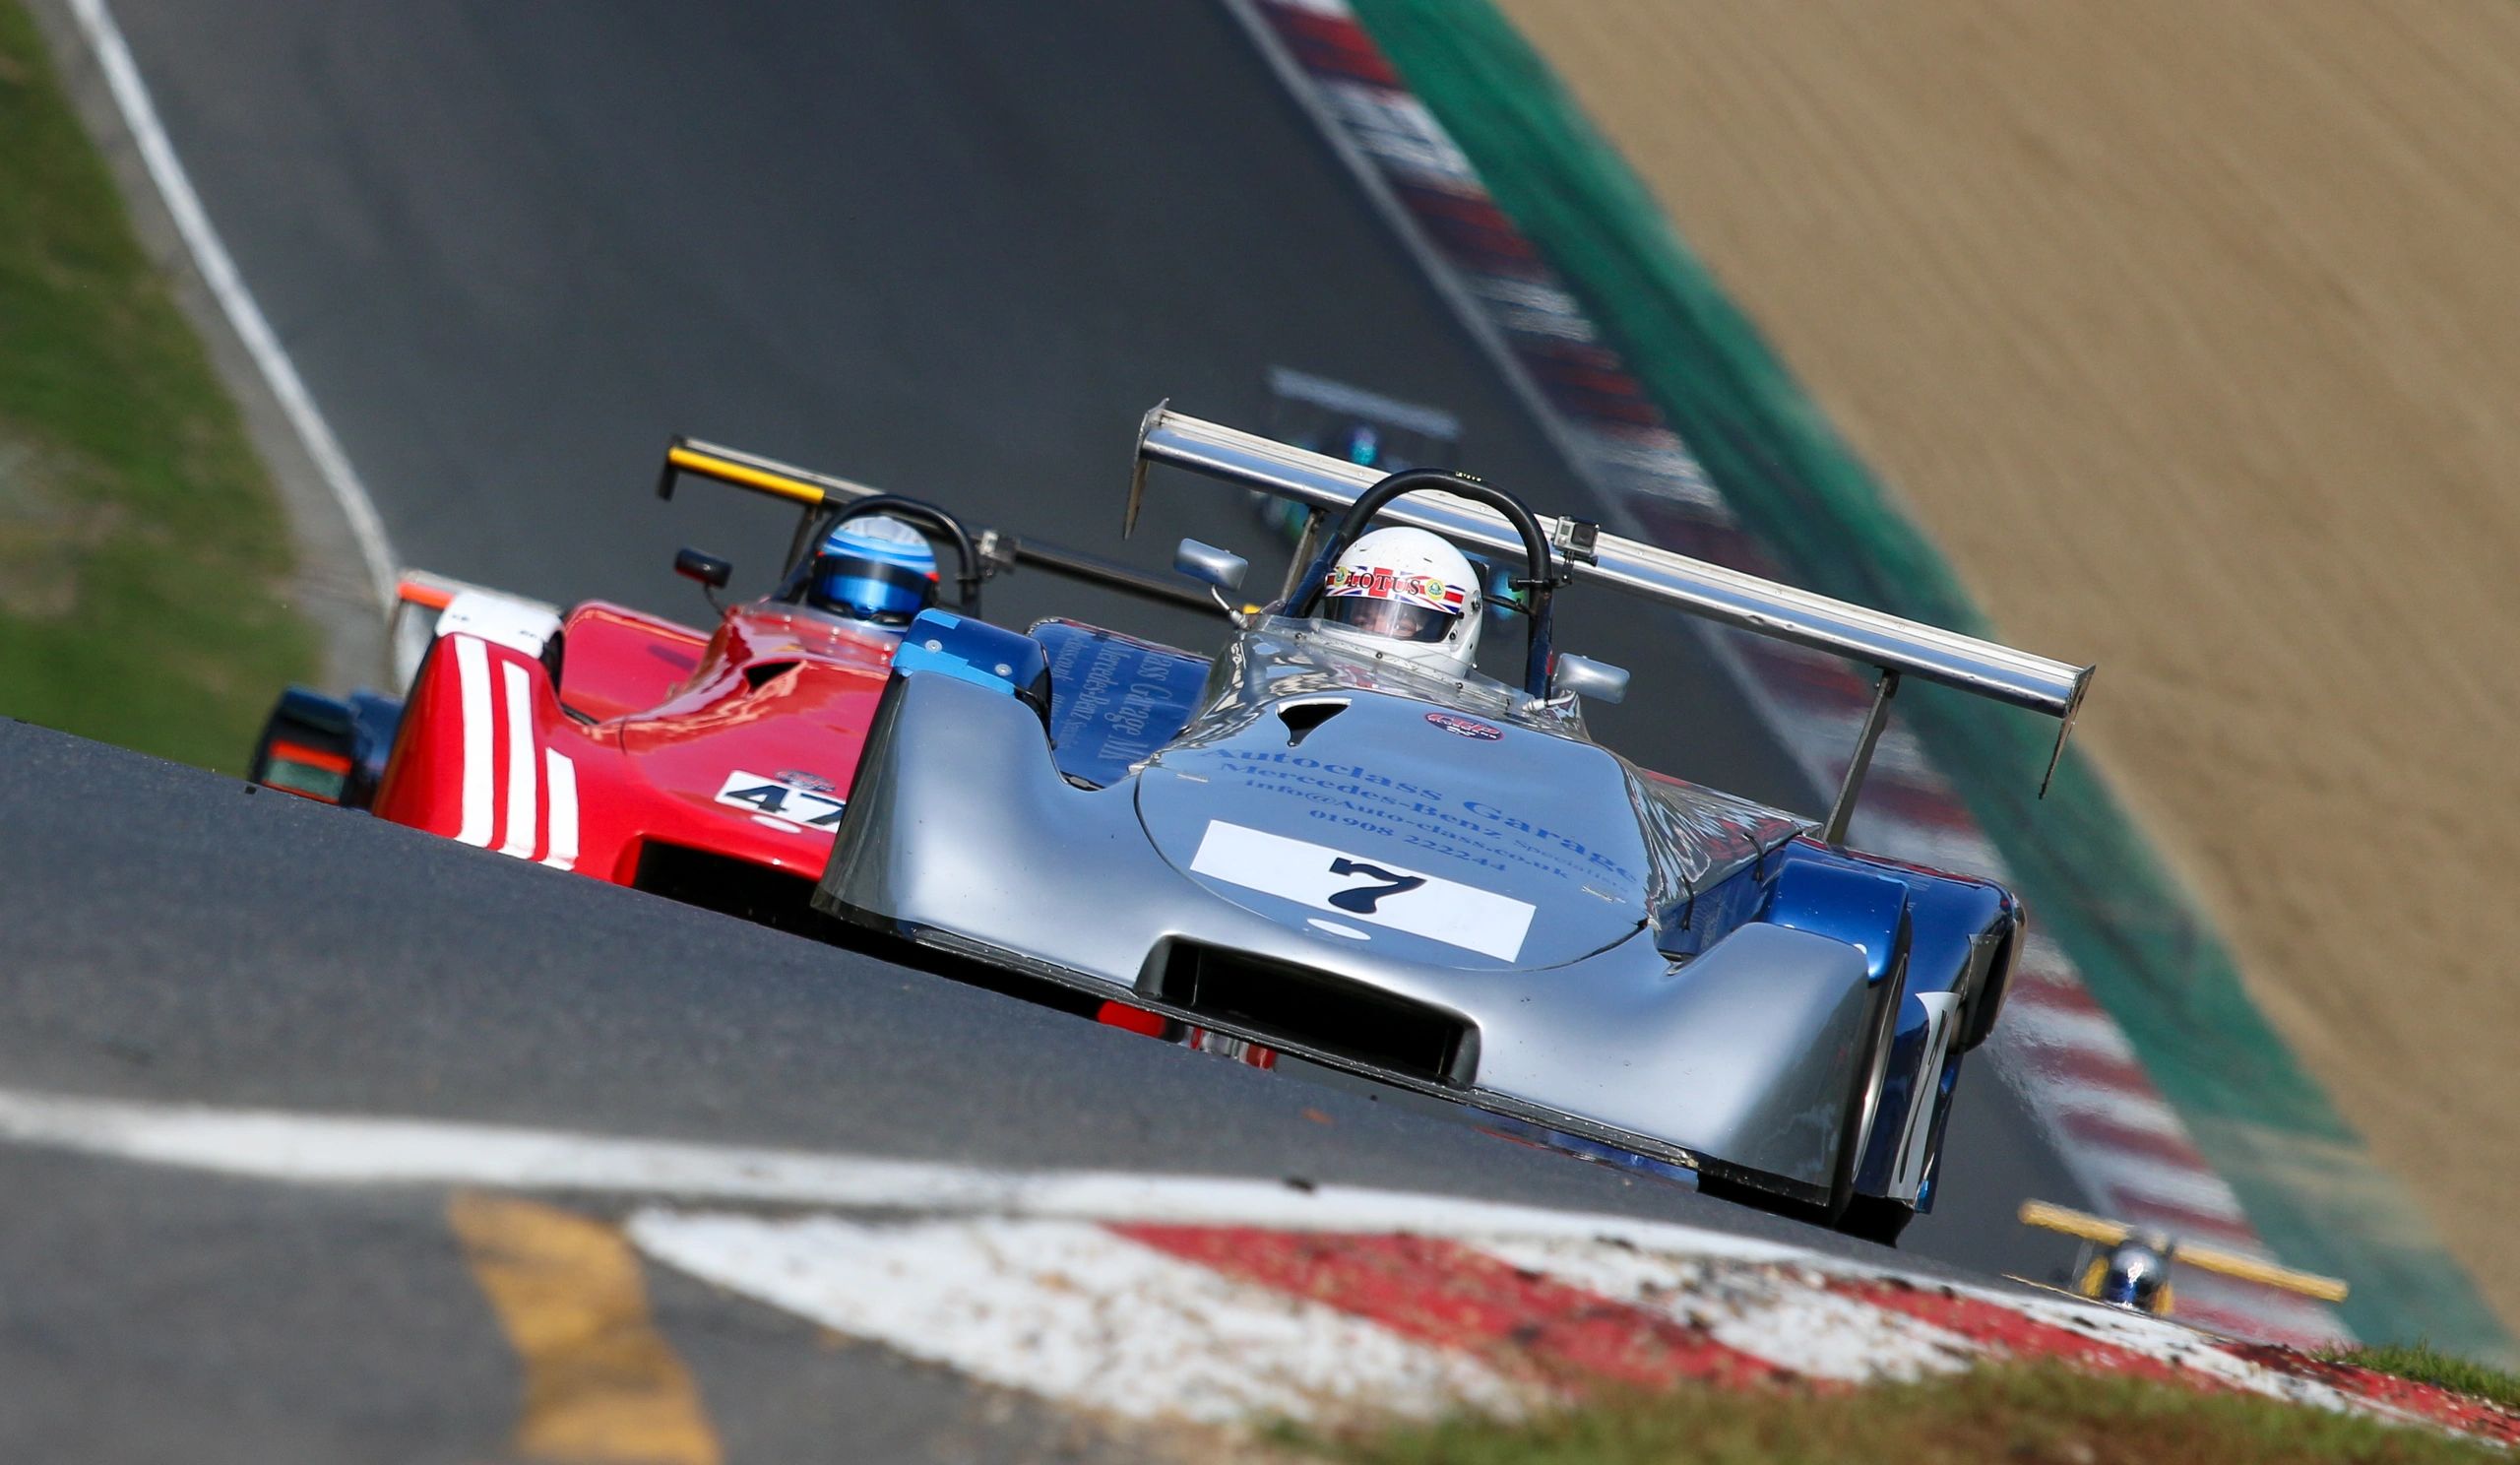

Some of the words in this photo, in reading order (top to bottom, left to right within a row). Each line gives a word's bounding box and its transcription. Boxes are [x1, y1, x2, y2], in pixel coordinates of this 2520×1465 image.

[1347, 569, 1421, 596] LOTUS
[1104, 682, 1174, 736] Garage
[1200, 749, 1443, 801] Autoclass
[1463, 801, 1637, 883] Garage
[1222, 763, 1503, 839] Mercedes-Benz
[1309, 809, 1395, 836] 01908
[1403, 835, 1507, 872] 222244
[1327, 857, 1427, 915] 7
